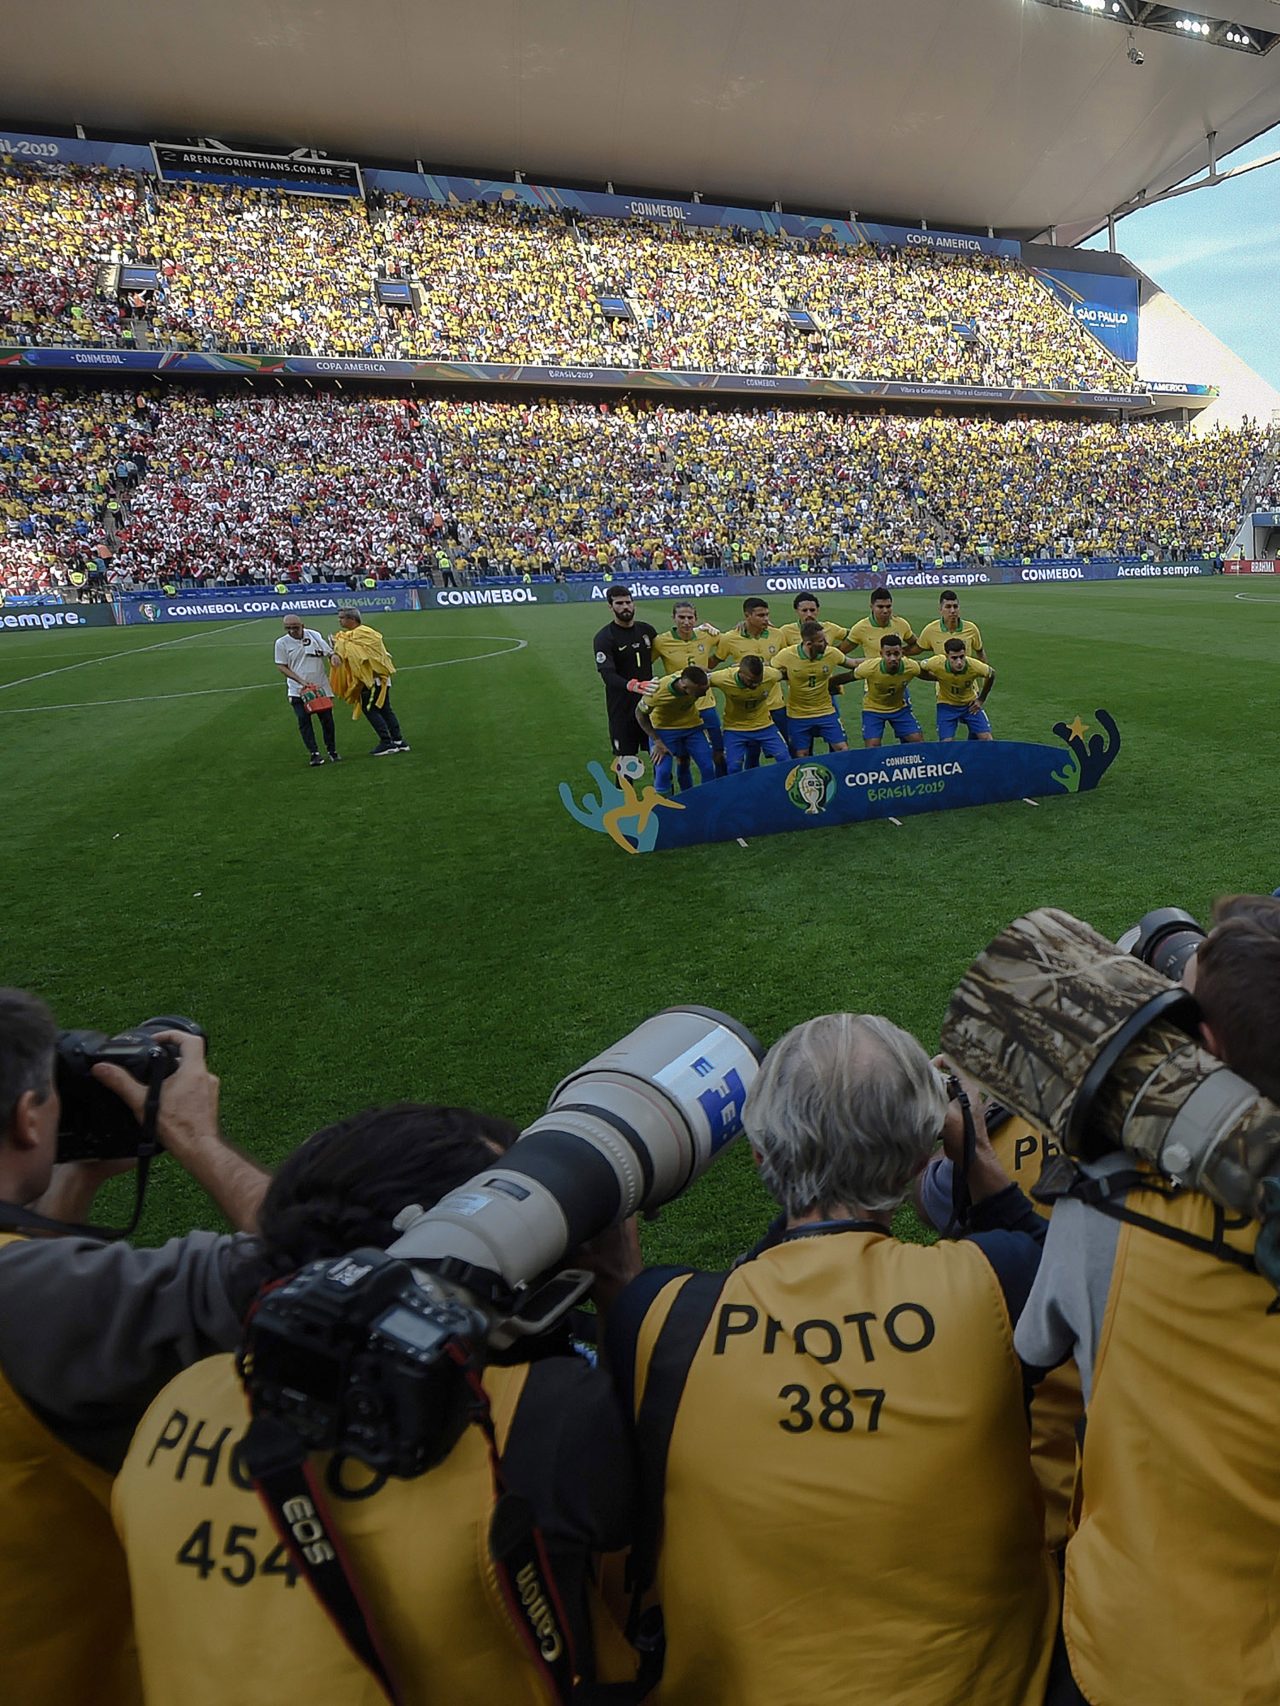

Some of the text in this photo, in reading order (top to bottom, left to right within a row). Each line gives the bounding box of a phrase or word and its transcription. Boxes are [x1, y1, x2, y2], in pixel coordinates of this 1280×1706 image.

[19, 142, 59, 157] 2019
[183, 153, 333, 177] ARENACORINTHIANS.COM.BR
[906, 233, 981, 251] COPA AMERICA
[1097, 311, 1128, 324] PAULO
[316, 361, 386, 373] COPA AMERICA
[1153, 384, 1188, 392] AMERICA
[1021, 568, 1084, 580] CONMEBOL
[1117, 564, 1202, 578] Acredite sempre.
[1251, 561, 1274, 573] BRAHMA
[766, 576, 845, 591] CONMEBOL
[885, 572, 990, 587] Acredite sempre.
[436, 588, 537, 606] CONMEBOL
[662, 582, 723, 598] sempre.
[167, 603, 239, 617] CONMEBOL
[243, 601, 279, 614] COPA
[281, 597, 336, 612] AMERICA
[845, 762, 963, 787] COPA AMERICA
[918, 780, 945, 794] 2019
[778, 1383, 887, 1434] 387
[282, 1494, 335, 1566] EOS
[516, 1561, 563, 1662] Canon
